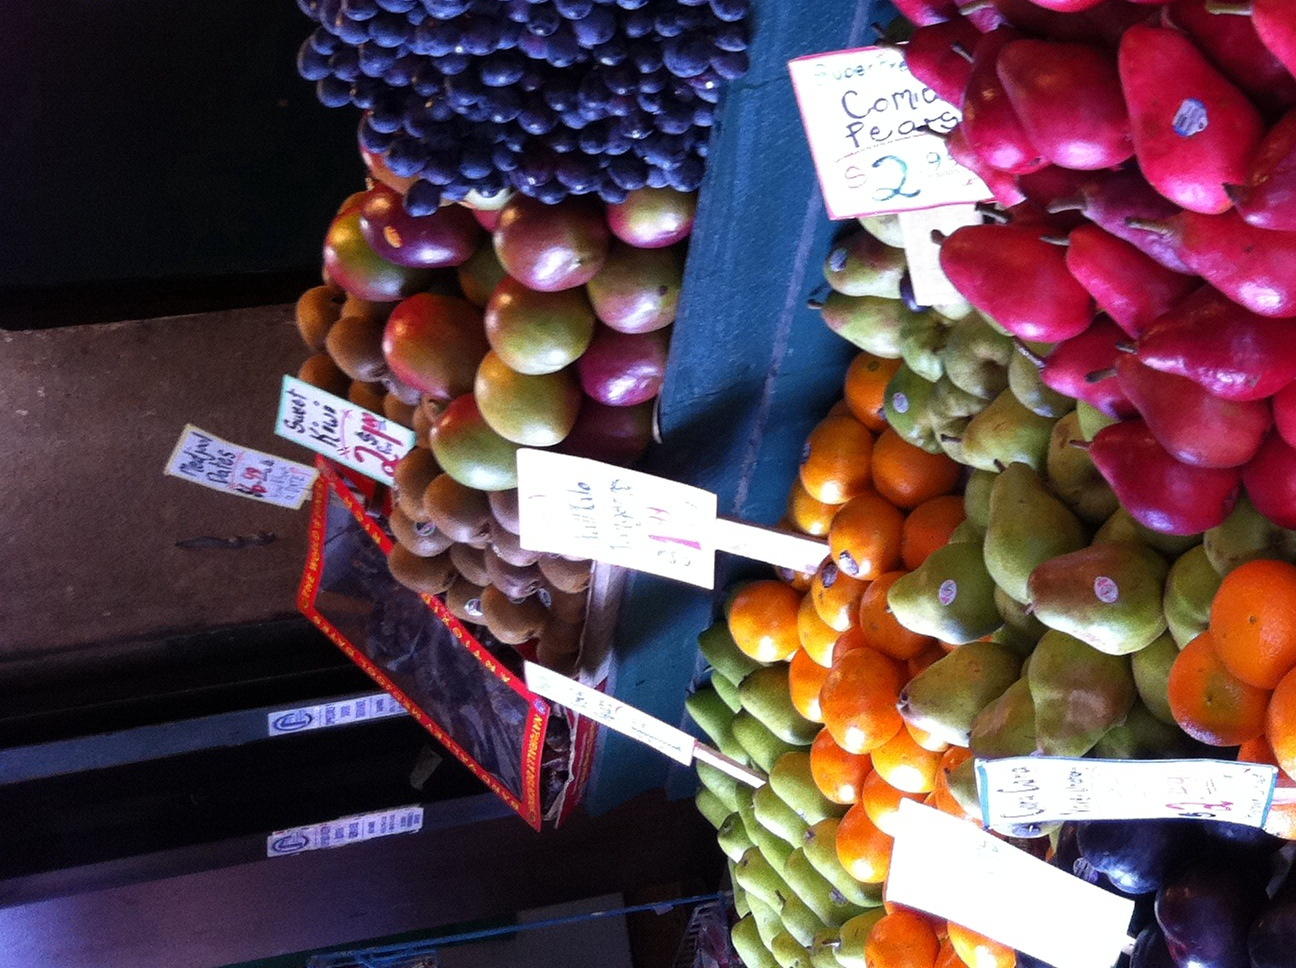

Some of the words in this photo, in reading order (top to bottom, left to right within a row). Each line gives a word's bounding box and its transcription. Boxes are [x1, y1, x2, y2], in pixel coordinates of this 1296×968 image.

[845, 111, 959, 147] Pears
[283, 389, 306, 434] Sweet
[310, 400, 341, 447] Kiwi
[206, 449, 236, 484] Dates
